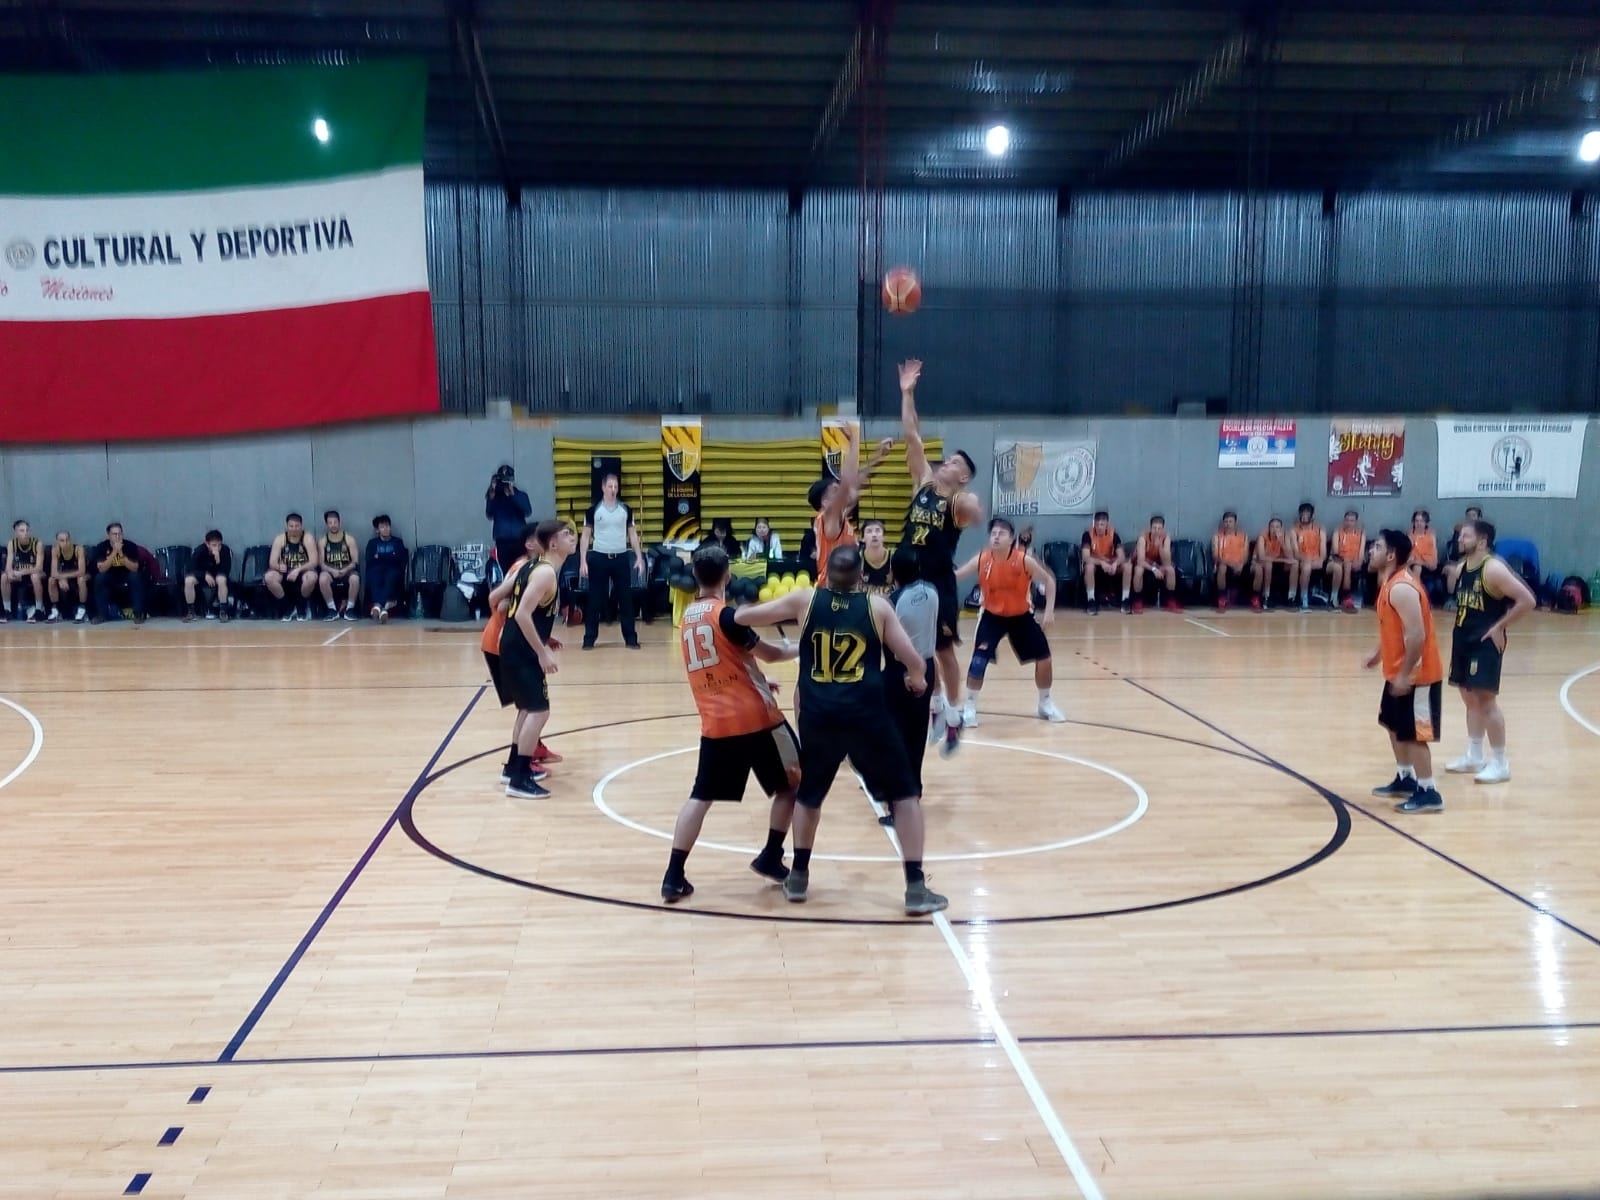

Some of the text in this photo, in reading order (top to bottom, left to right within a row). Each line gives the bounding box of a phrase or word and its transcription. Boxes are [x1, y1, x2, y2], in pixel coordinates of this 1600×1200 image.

[43, 215, 355, 269] CULTURAL Y DEPORTIVA
[683, 625, 720, 673] 13
[811, 631, 866, 683] 12
